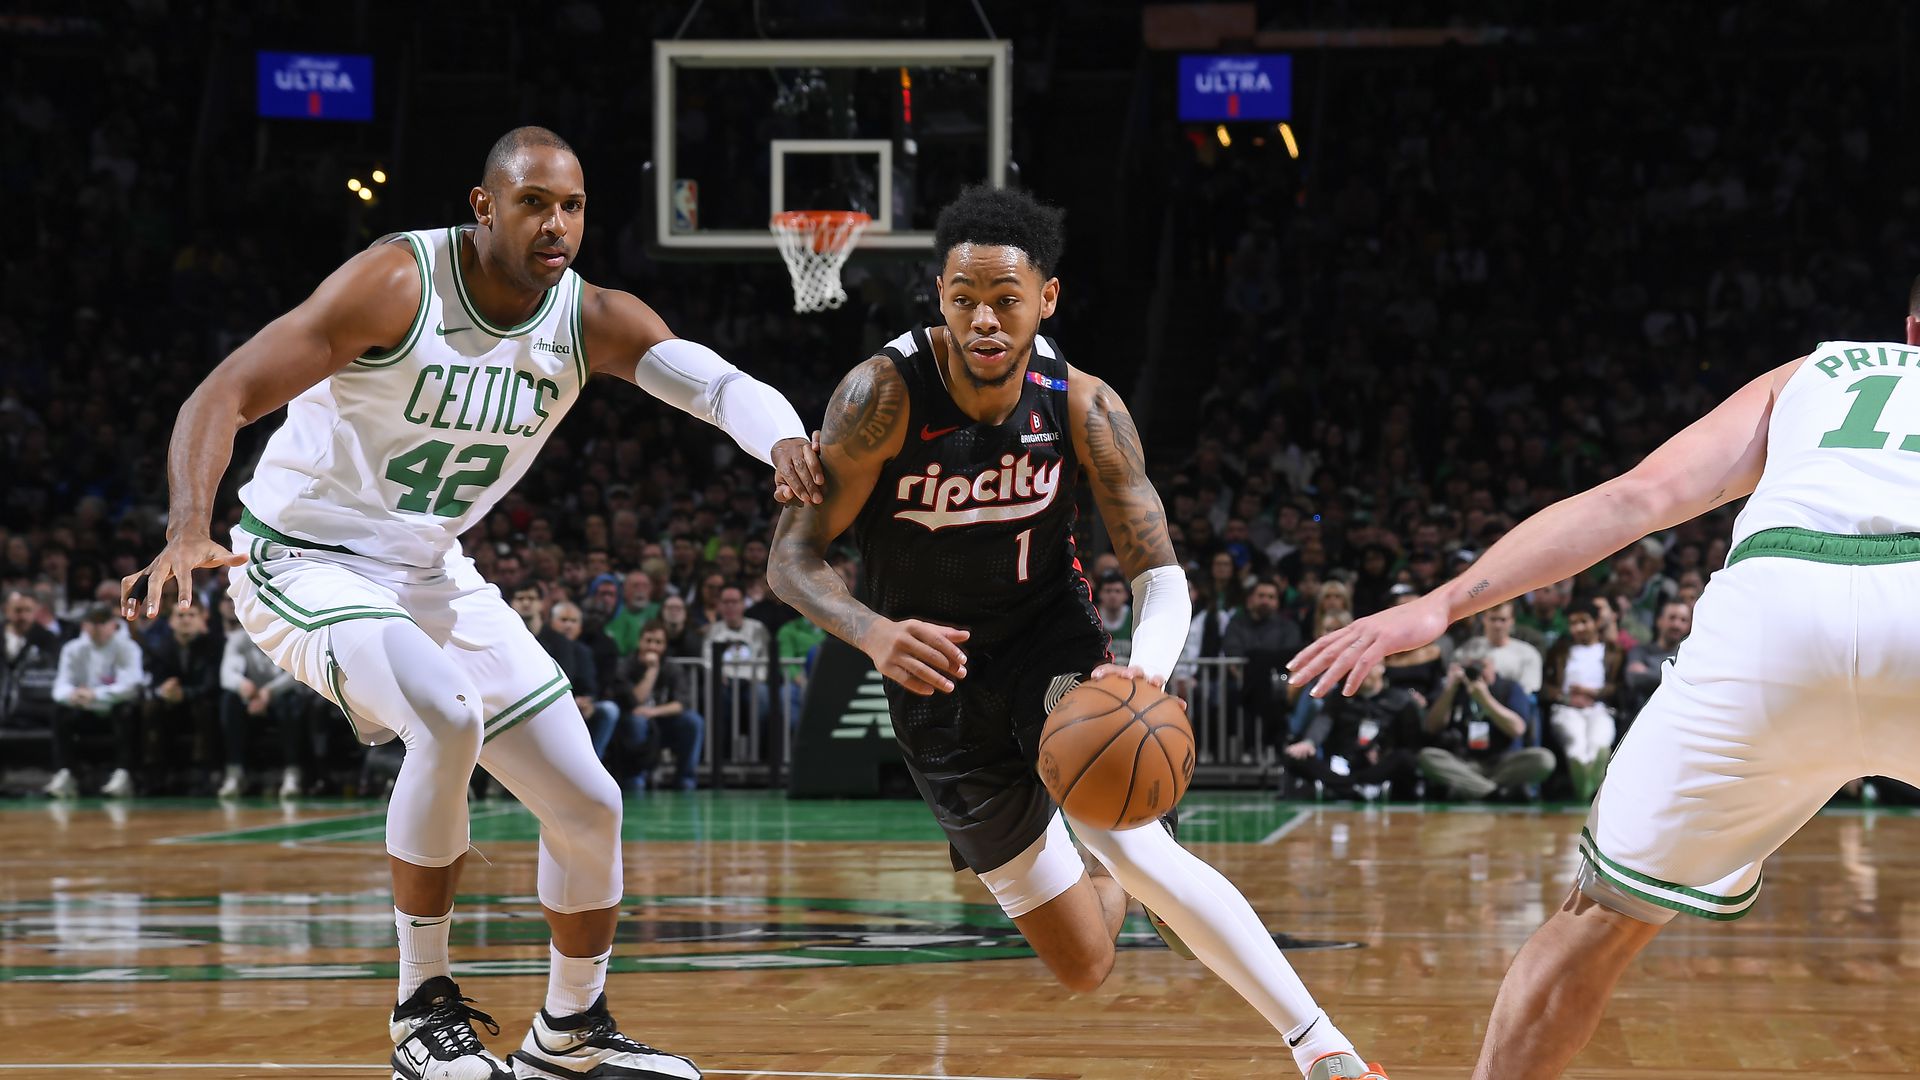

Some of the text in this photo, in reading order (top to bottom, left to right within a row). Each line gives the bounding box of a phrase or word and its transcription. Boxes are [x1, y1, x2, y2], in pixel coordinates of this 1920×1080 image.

[274, 69, 354, 92] ULTRA
[1195, 71, 1272, 93] ULTRA
[533, 337, 570, 354] Amica
[1815, 346, 1920, 378] PRIT
[403, 364, 559, 437] CELTICS
[1818, 374, 1920, 453] 1
[385, 439, 509, 518] 42
[894, 450, 1063, 530] ripcity
[1015, 528, 1034, 583] 1
[1467, 579, 1489, 598] 1998
